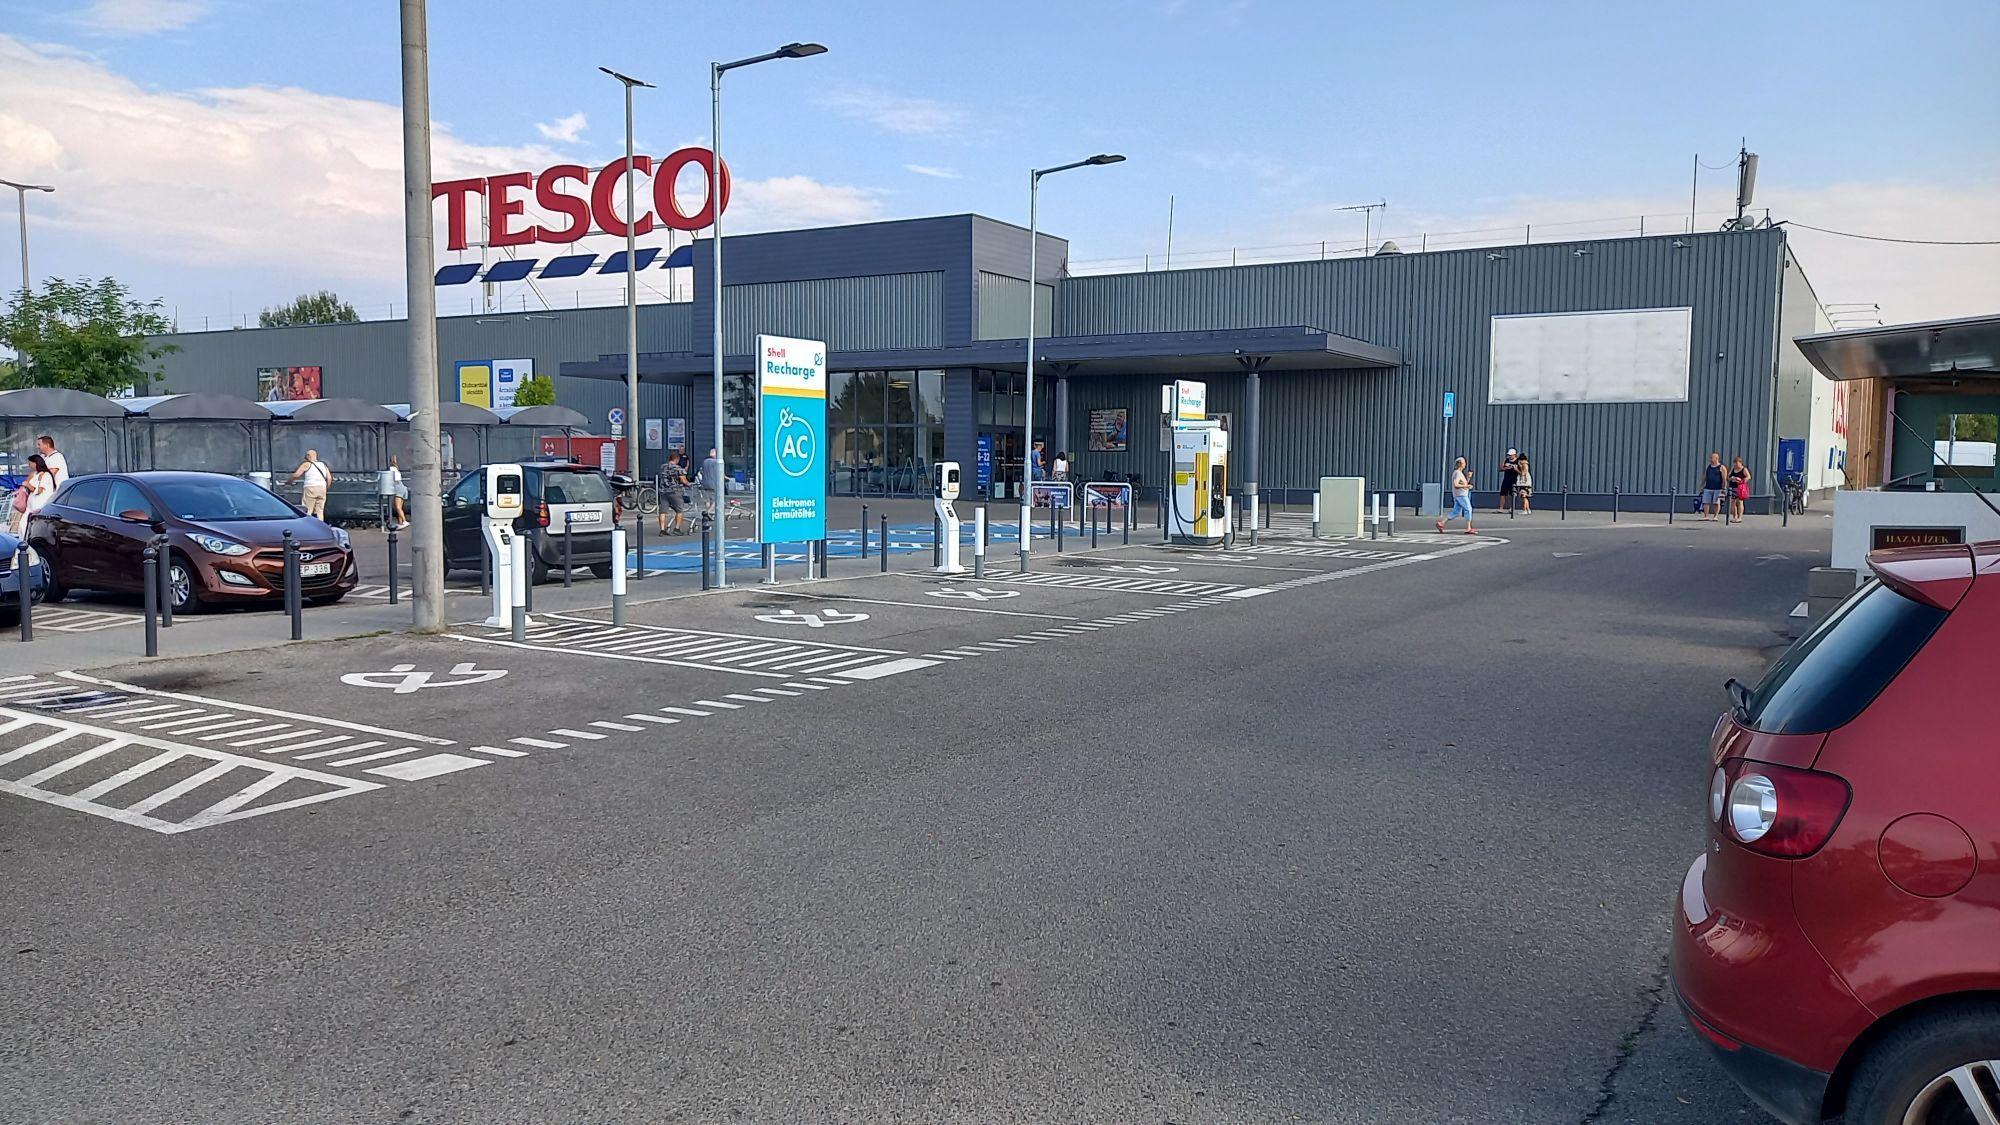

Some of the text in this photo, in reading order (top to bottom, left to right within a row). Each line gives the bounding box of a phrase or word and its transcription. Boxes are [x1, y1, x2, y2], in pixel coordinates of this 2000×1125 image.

[431, 146, 730, 250] TESCO
[767, 347, 786, 358] Shell
[767, 361, 815, 380] Recharge
[1180, 397, 1201, 408] Recharge
[782, 434, 808, 459] AC
[772, 497, 816, 508] Elektromos
